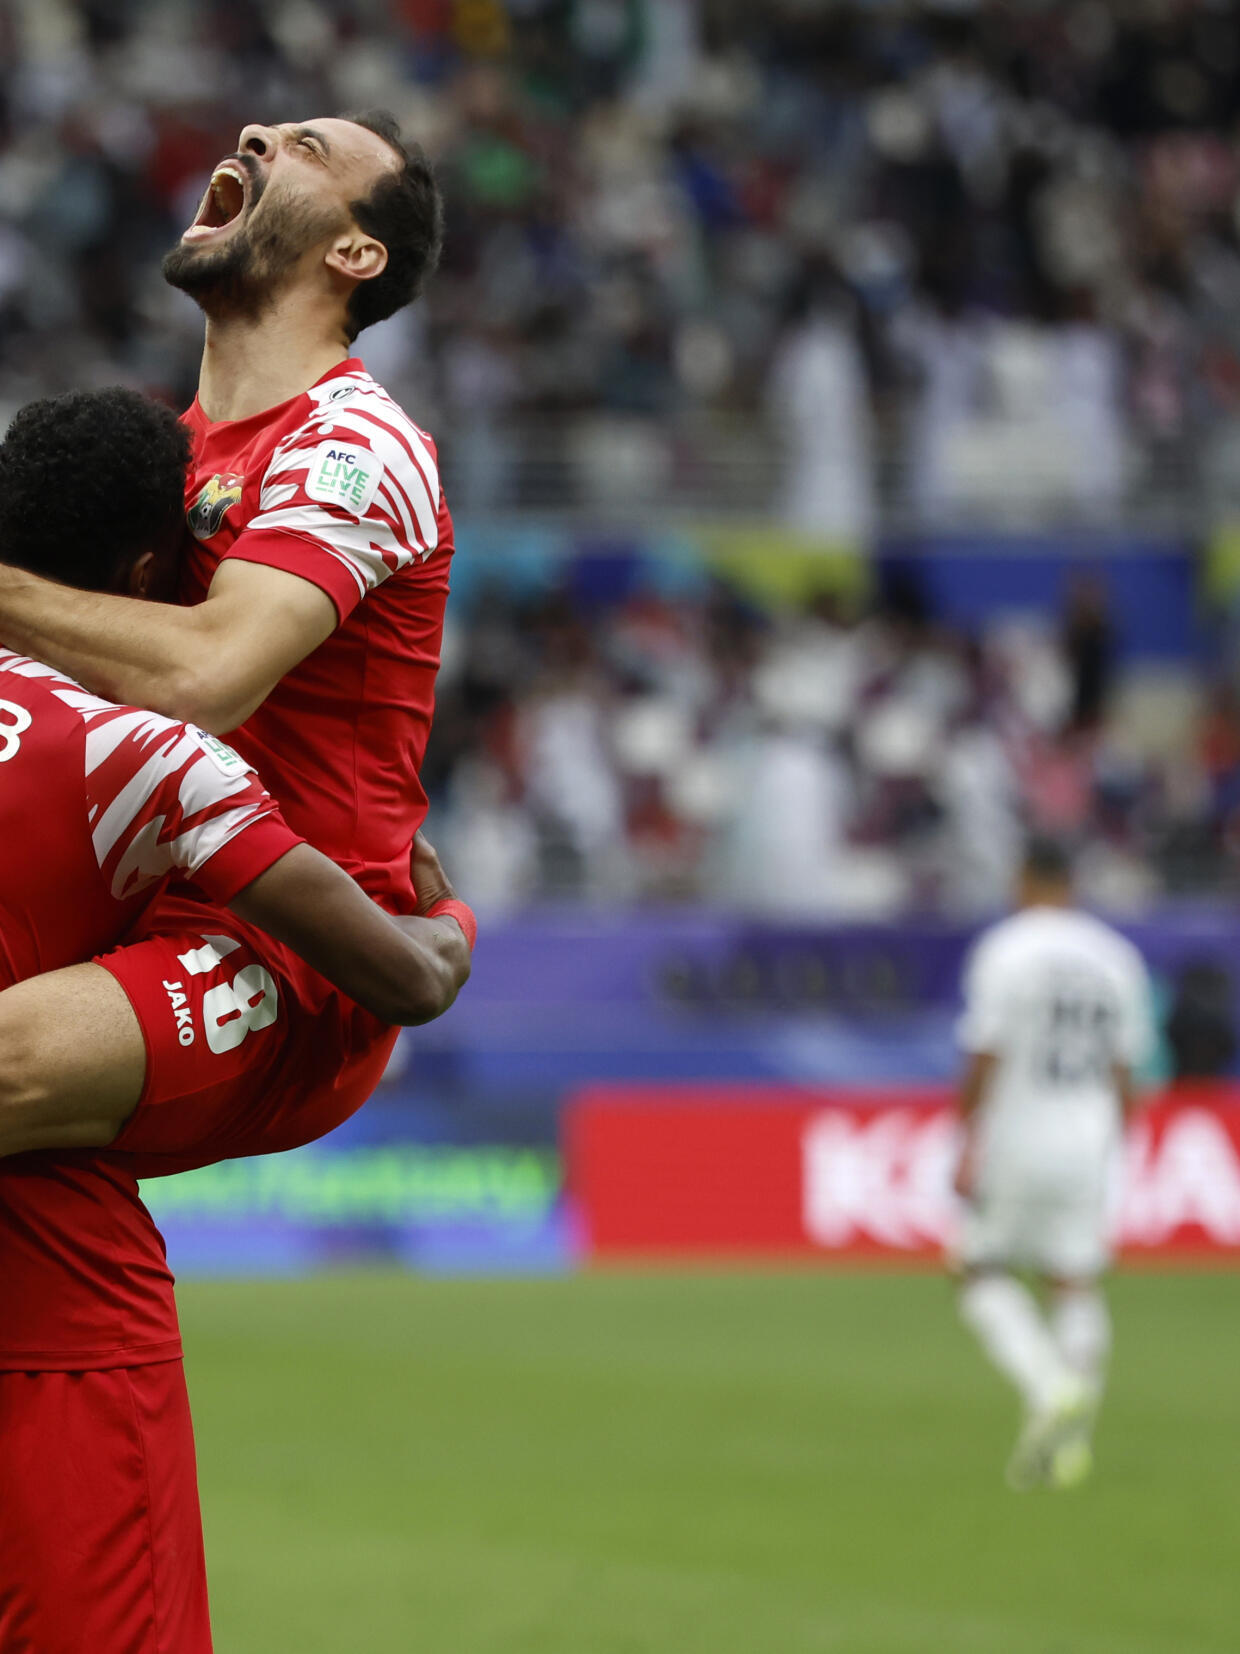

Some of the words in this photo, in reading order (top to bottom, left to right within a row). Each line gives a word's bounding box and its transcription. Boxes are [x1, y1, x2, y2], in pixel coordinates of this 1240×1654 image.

[320, 460, 370, 489] LIVE
[326, 450, 356, 465] AFC
[162, 980, 195, 1047] JAKO
[176, 934, 278, 1055] 18
